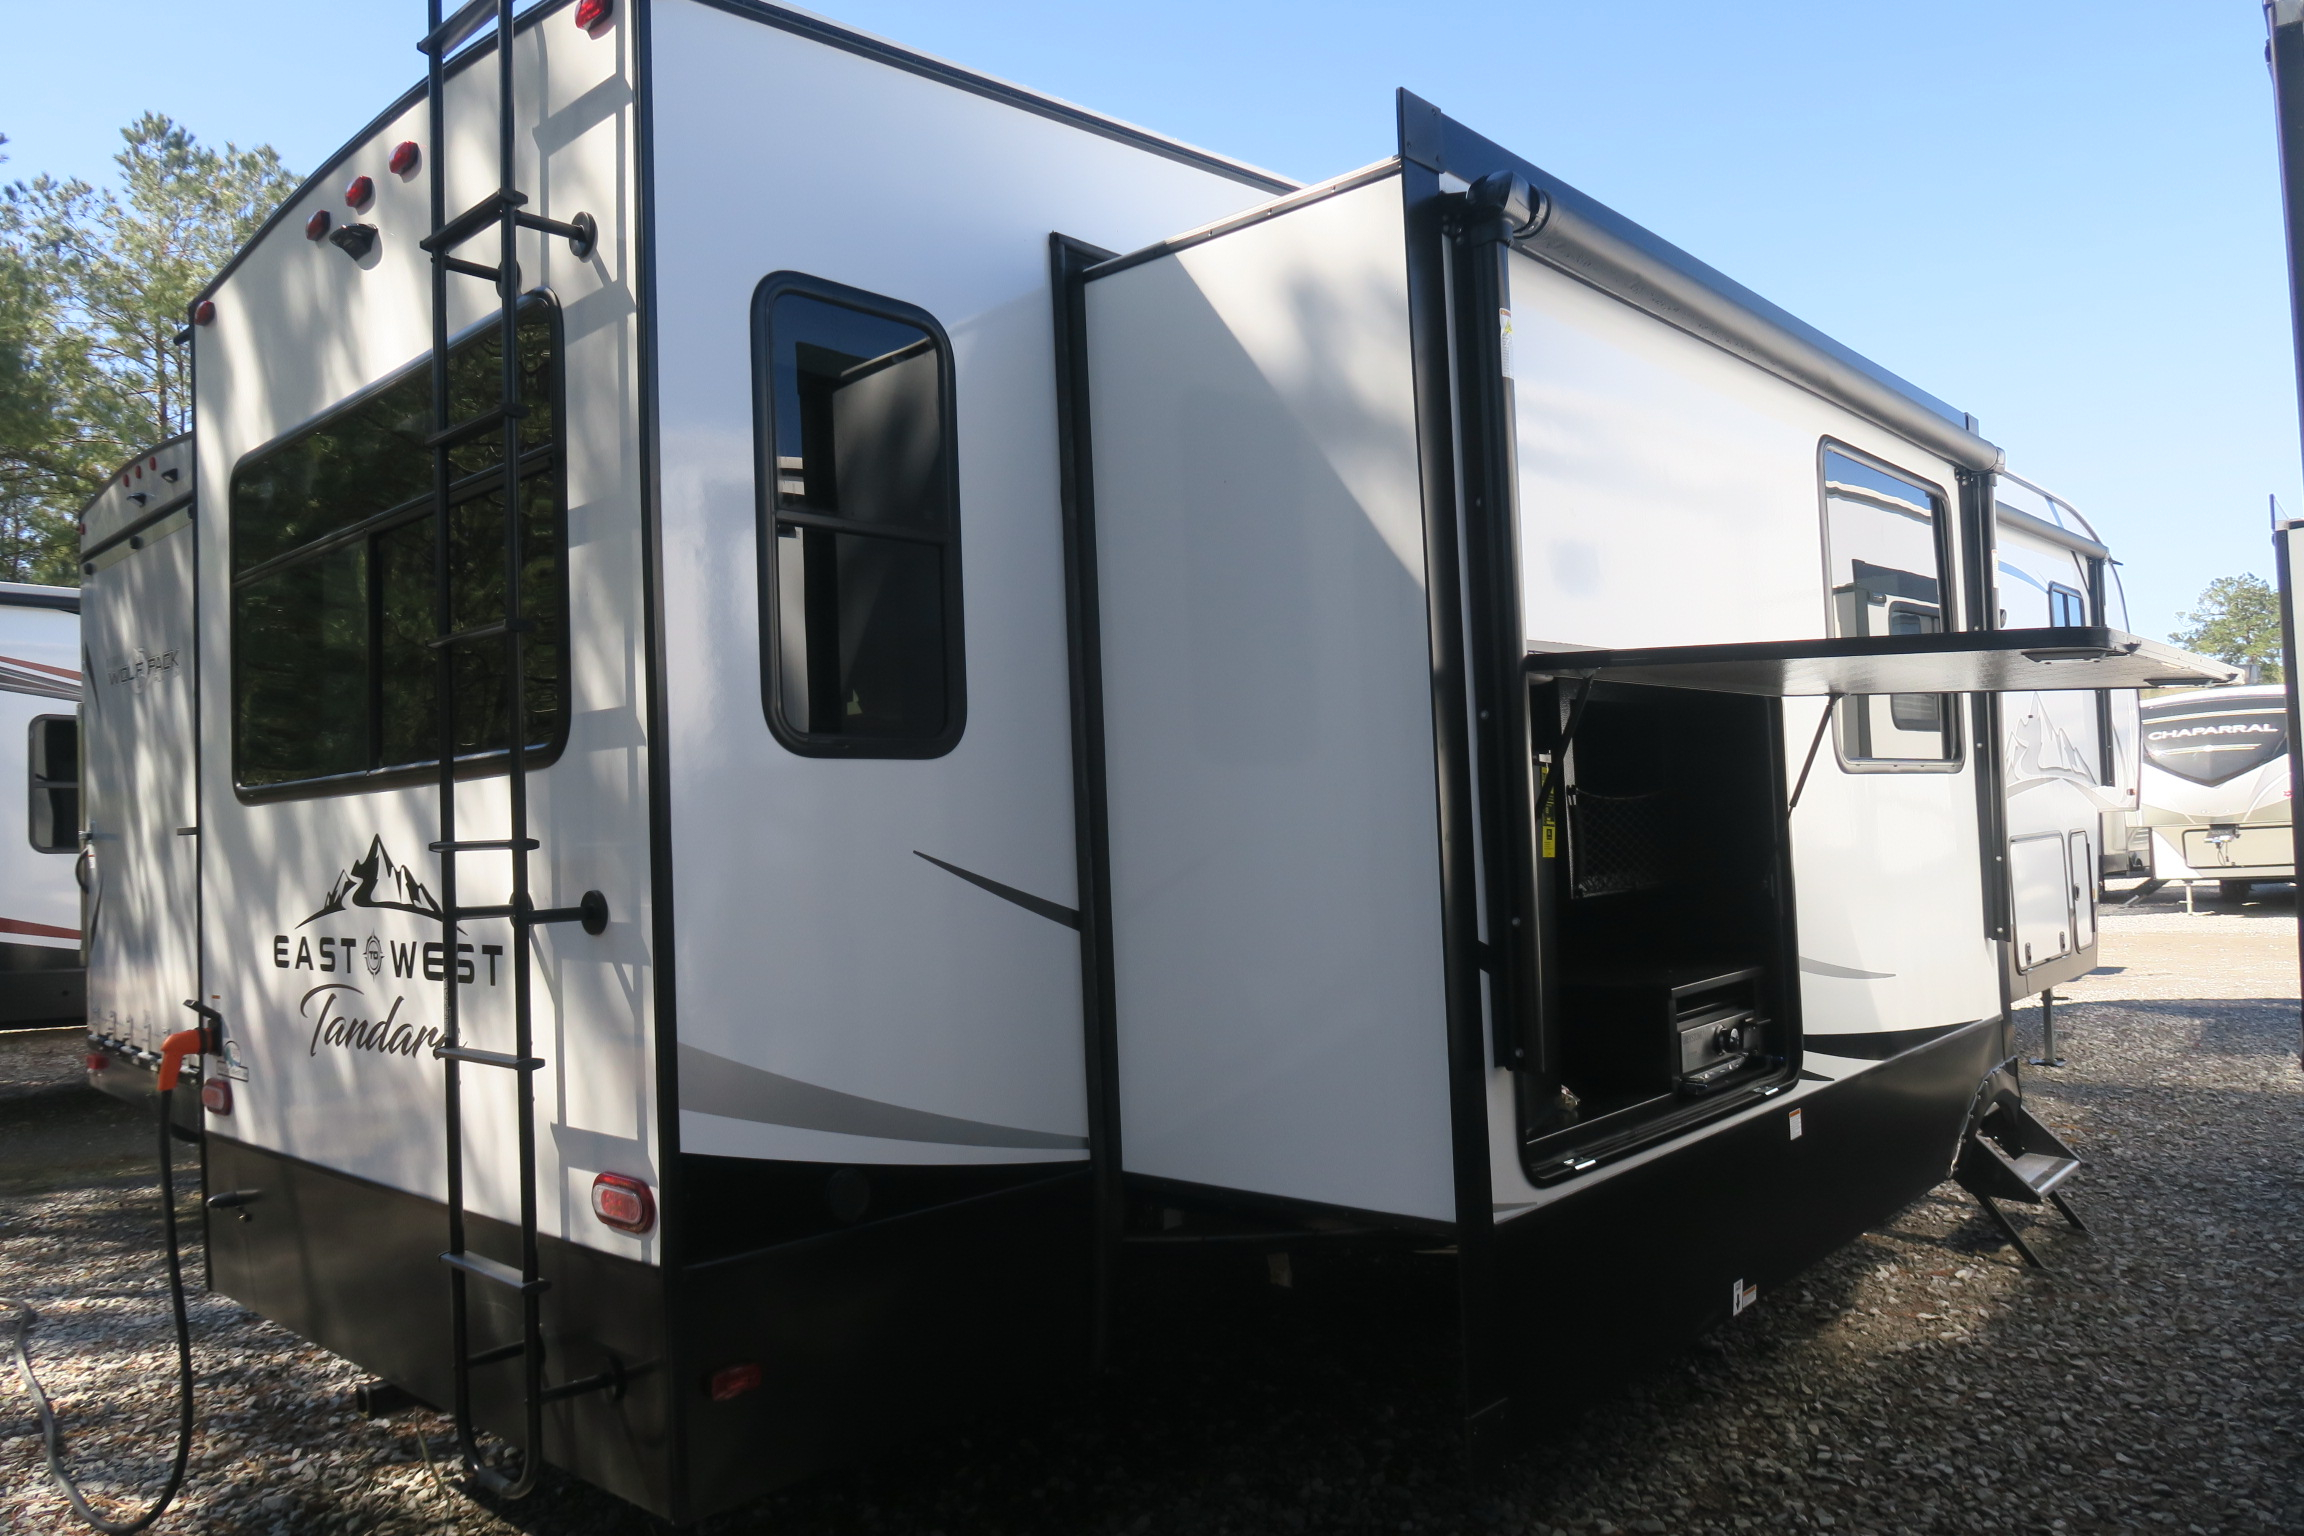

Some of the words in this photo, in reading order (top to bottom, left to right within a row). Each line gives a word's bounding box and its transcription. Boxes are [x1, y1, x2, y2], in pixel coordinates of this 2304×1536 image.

[107, 662, 144, 686] WOLF
[147, 648, 180, 675] PACK
[2148, 723, 2278, 741] CHAPARRAL
[273, 934, 357, 974] EAST
[369, 950, 379, 960] TO
[390, 940, 503, 986] WEST
[300, 984, 468, 1058] Tandar
